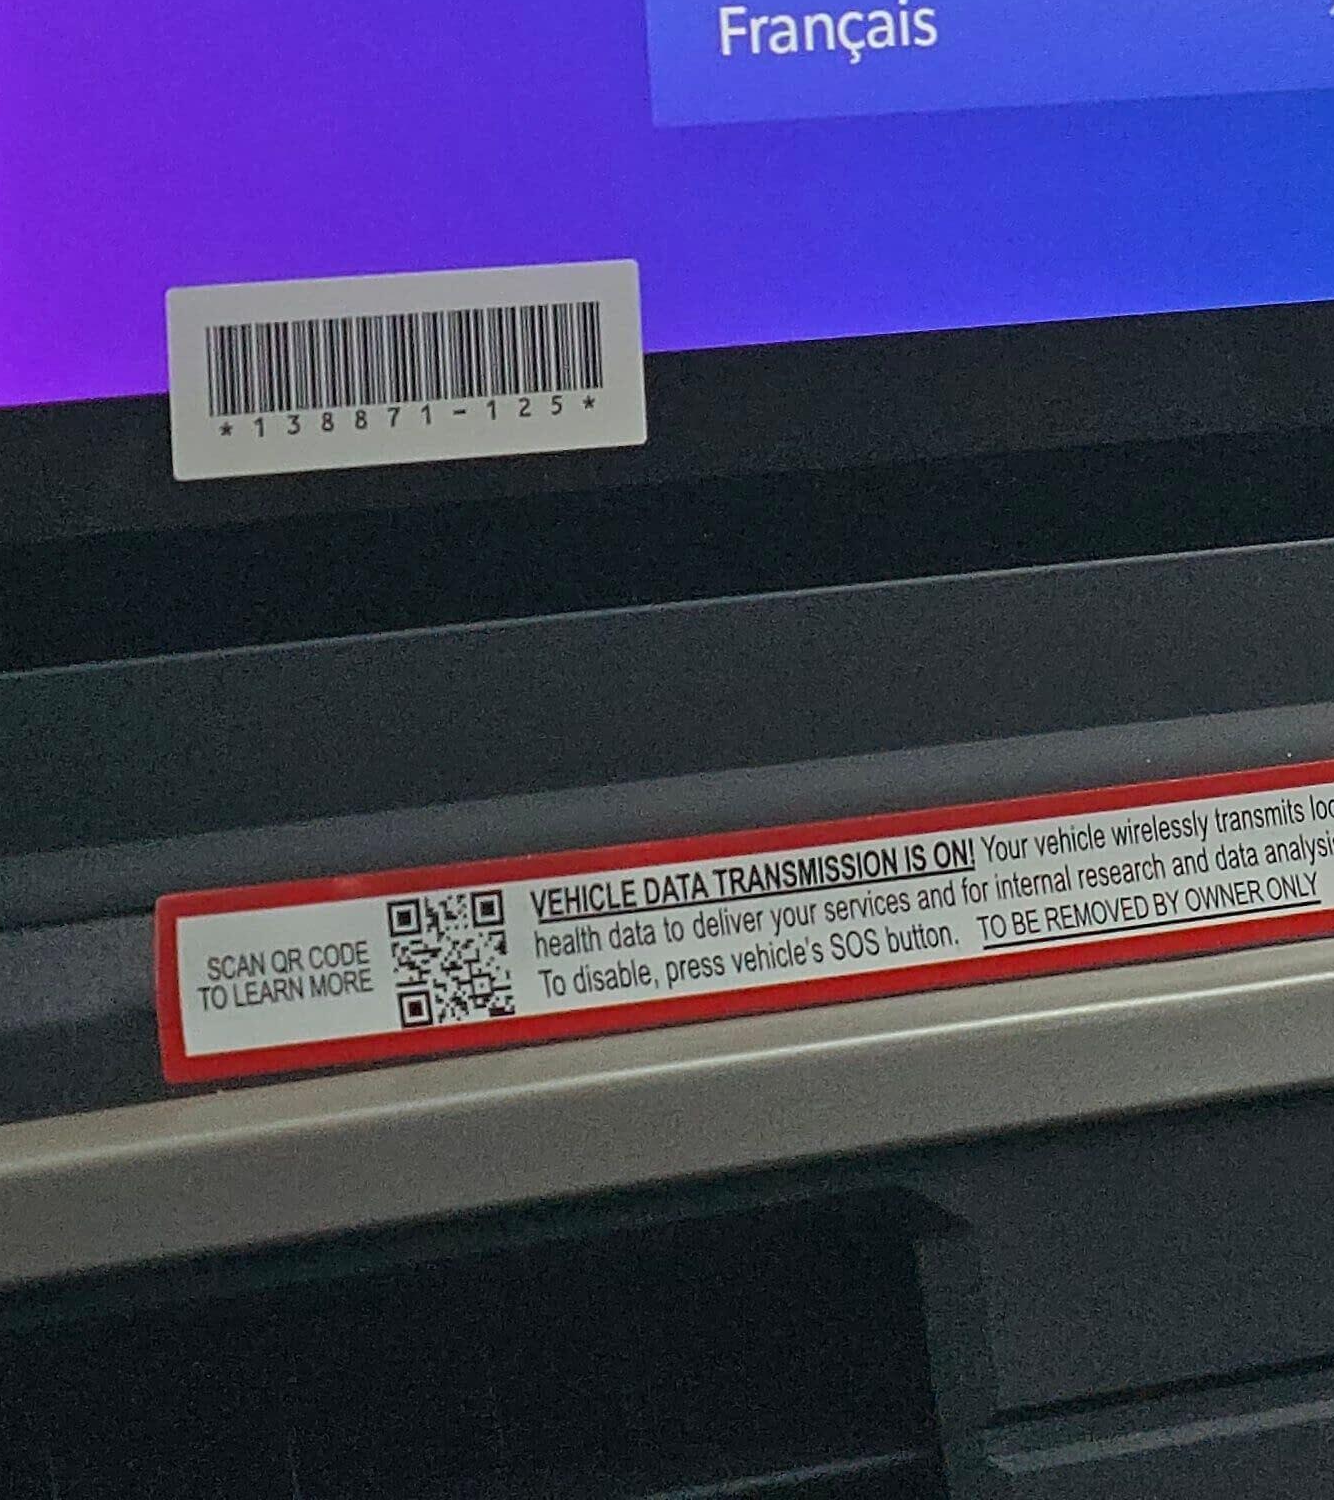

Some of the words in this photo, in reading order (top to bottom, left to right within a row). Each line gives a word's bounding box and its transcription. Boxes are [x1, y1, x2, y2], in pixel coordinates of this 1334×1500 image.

[530, 879, 637, 918] VEHICLE
[643, 870, 709, 908] DATA
[712, 849, 898, 897] TRANSMISSION
[905, 845, 927, 872] IS
[934, 838, 975, 869] ON!
[980, 835, 1029, 863] Your
[1035, 825, 1106, 857] vehicle
[1111, 811, 1209, 845] wirelessly
[1215, 799, 1305, 833] transmits
[534, 921, 602, 958] health
[609, 916, 658, 947] data
[663, 915, 686, 943] to
[692, 903, 764, 939] deliver
[770, 902, 817, 941] your
[824, 889, 909, 924] services
[917, 877, 957, 911] and
[961, 878, 992, 905] for
[996, 865, 1073, 901] internal
[1078, 853, 1166, 889] research
[1171, 847, 1209, 877] and
[1215, 841, 1258, 871] data
[976, 913, 1007, 942] TO
[1013, 907, 1041, 934] BE
[1046, 893, 1149, 932] REMOVED
[1155, 887, 1180, 915] BY
[1185, 878, 1262, 912] OWNER
[1267, 871, 1318, 901] ONLY
[198, 986, 228, 1011] TO
[234, 977, 304, 1008] LEARN
[310, 969, 374, 998] MORE
[207, 951, 265, 981] SCAN
[270, 946, 304, 973] QR
[309, 941, 369, 970] CODE
[537, 968, 567, 999] To
[572, 956, 660, 993] disable,
[666, 956, 726, 991] press
[731, 937, 825, 973] vehicle's
[830, 929, 881, 962] SOS
[887, 920, 960, 955] button.
